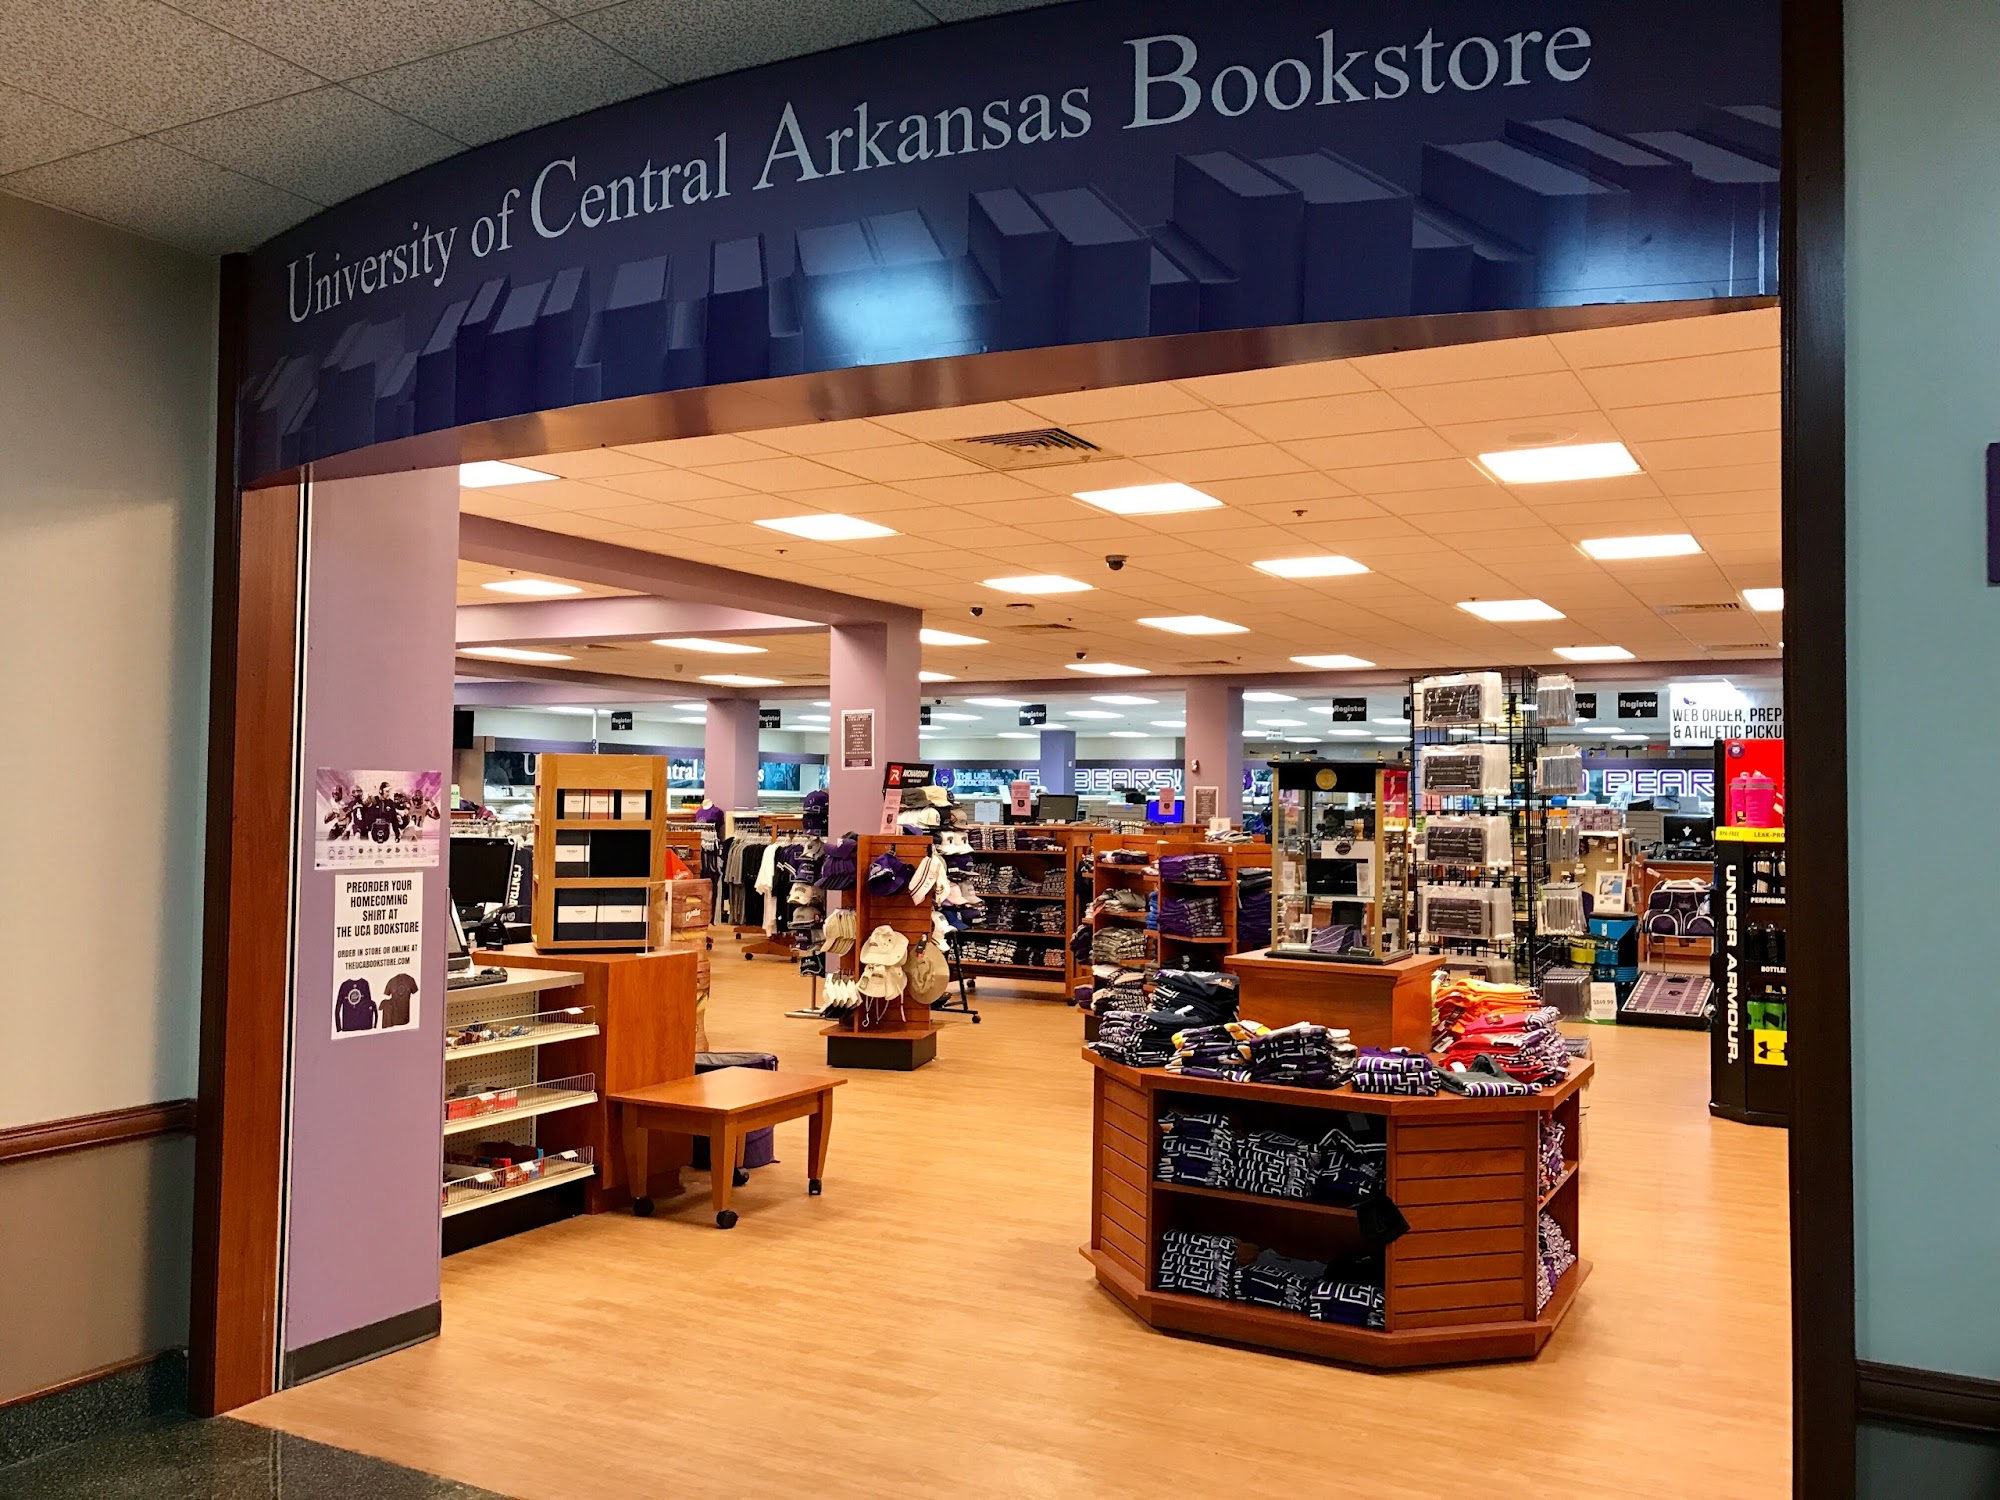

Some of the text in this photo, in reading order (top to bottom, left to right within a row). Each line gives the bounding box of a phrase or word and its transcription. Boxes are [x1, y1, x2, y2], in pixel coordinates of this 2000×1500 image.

[287, 25, 1592, 324] University of Central Arkansas Bookstore
[1333, 705, 1365, 714] Register
[1620, 700, 1657, 709] Register
[1634, 709, 1641, 717] 4
[1673, 708, 1784, 723] WEB ORDER, PREP
[1674, 725, 1681, 738] &
[1685, 725, 1741, 738] ATHLETIC
[1075, 769, 1182, 792] BEARS!
[346, 880, 412, 893] PREORDER YOUR
[350, 894, 408, 907] HOMECOMING
[1726, 864, 1737, 947] UNDER
[362, 909, 398, 921] SHIRT AT
[337, 921, 419, 938] THE UCA BOOKSTORE
[337, 949, 356, 958] ORDER
[357, 948, 363, 956] IN
[364, 946, 382, 956] STORE
[383, 946, 391, 954] OR
[391, 944, 410, 953] ONLINE
[345, 957, 411, 970] THEUCABOOKSTORE.COM
